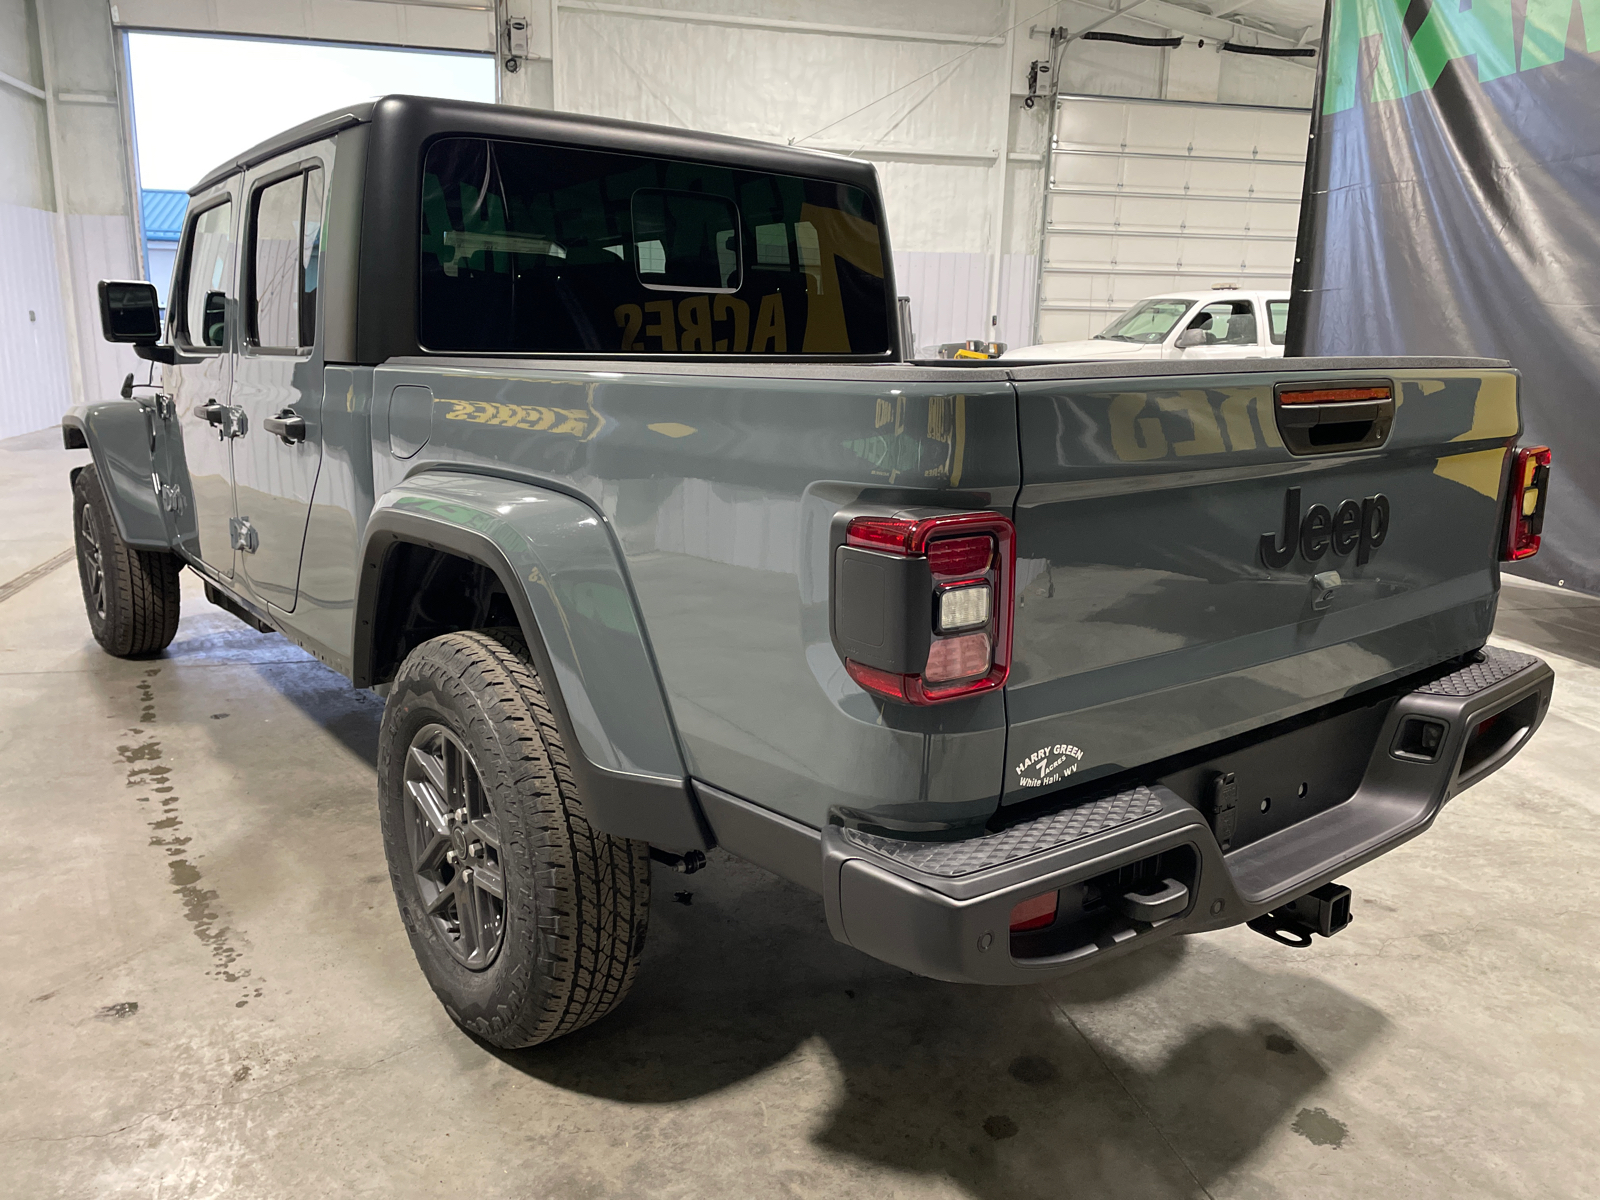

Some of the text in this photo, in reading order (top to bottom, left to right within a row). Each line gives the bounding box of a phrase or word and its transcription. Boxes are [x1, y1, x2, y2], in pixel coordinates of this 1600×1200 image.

[1260, 485, 1390, 569] Jeep
[1016, 744, 1084, 775] HARRY GREEN
[1035, 755, 1067, 778] 7 ACRES
[1019, 763, 1078, 787] White Hall, WV
